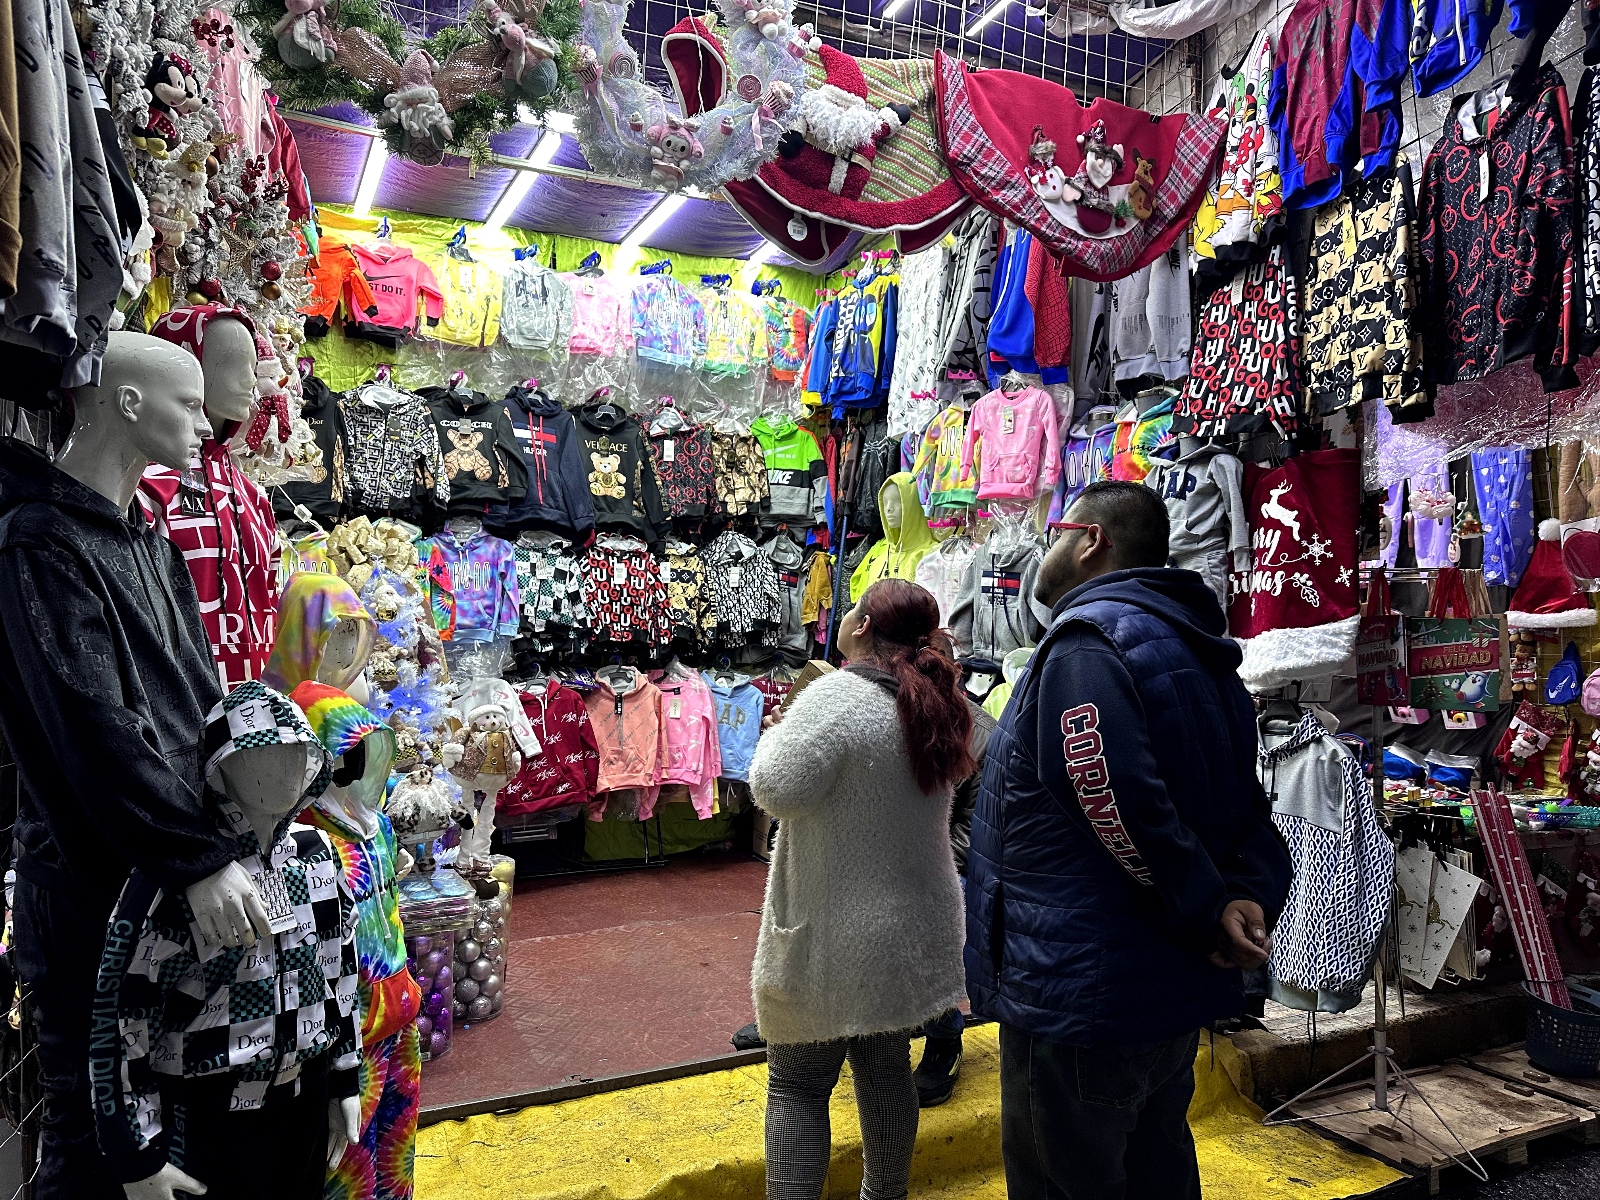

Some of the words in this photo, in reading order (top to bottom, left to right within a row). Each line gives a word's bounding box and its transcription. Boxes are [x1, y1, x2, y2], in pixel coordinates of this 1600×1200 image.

[381, 284, 394, 293] DO
[307, 417, 324, 426] Dior
[440, 419, 492, 430] COCH
[1443, 645, 1468, 653] FELIZ
[1421, 650, 1491, 670] NAVIDAD
[239, 704, 256, 729] Dior
[717, 700, 746, 730] AP
[1061, 703, 1153, 885] CORNELL
[274, 844, 295, 855] Dior
[311, 876, 335, 889] Dior
[244, 954, 271, 970] Dior
[236, 1033, 271, 1051] Dior
